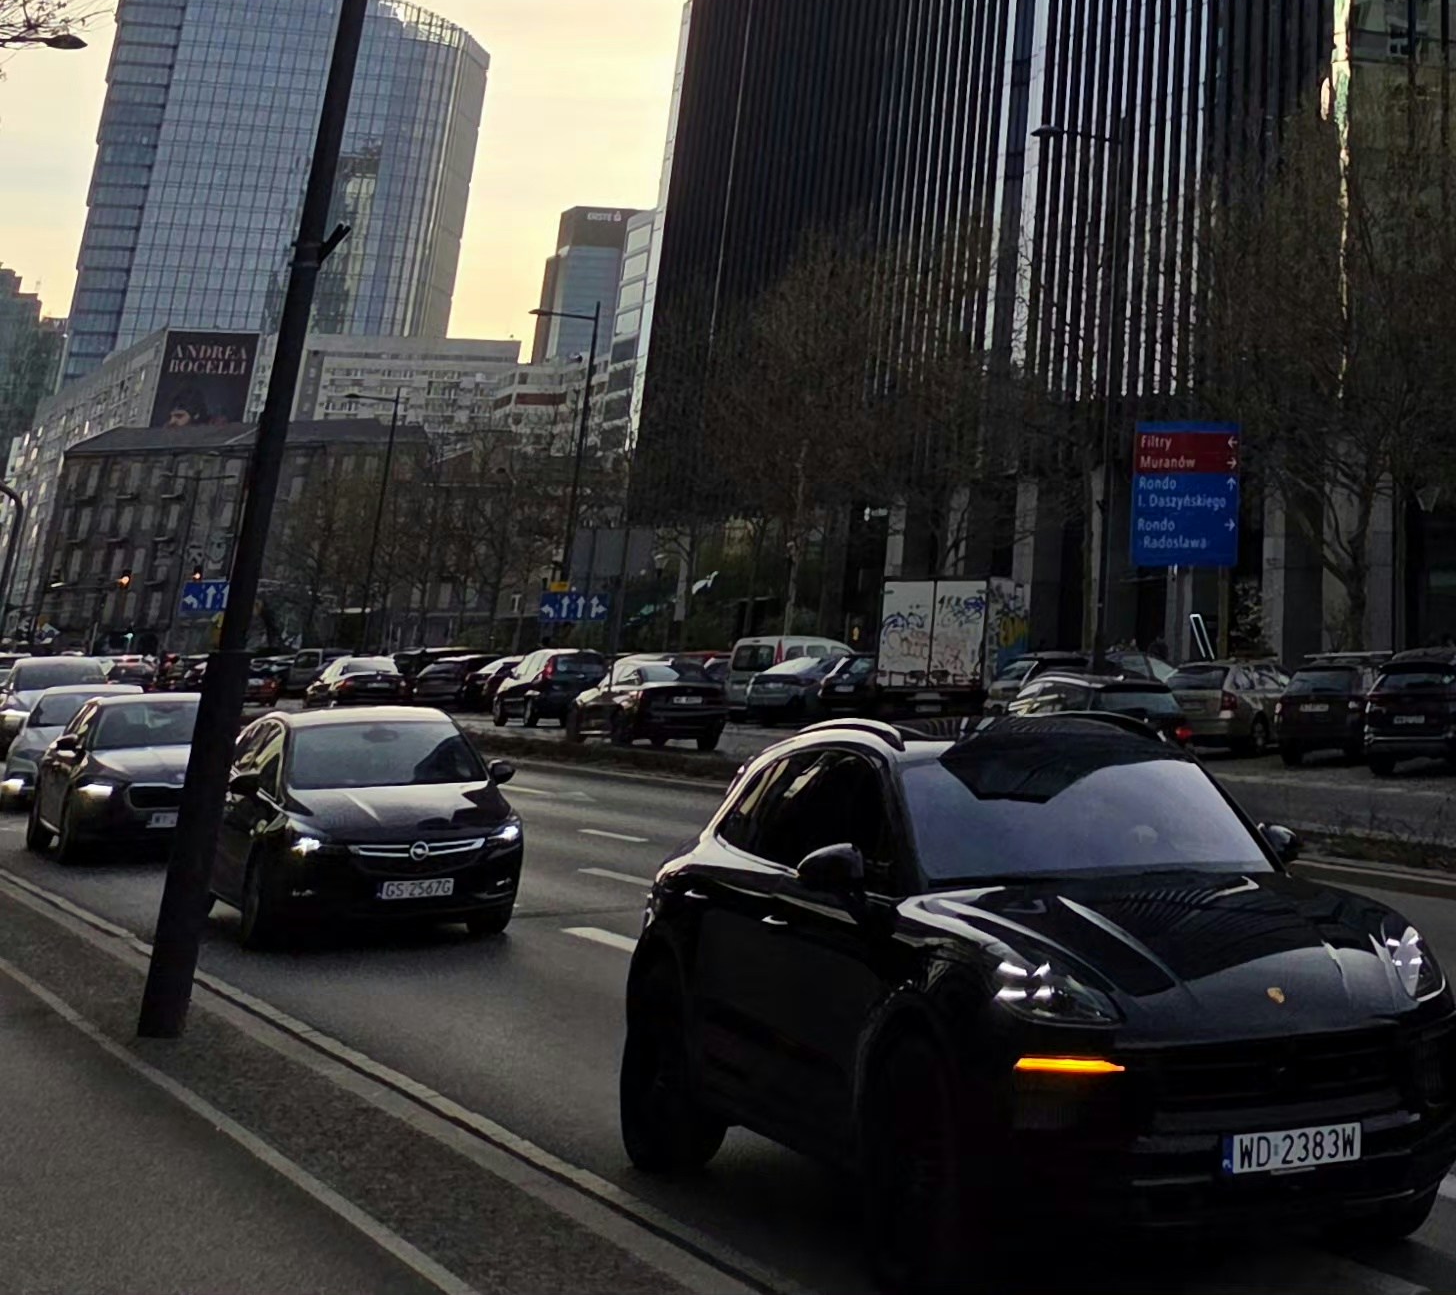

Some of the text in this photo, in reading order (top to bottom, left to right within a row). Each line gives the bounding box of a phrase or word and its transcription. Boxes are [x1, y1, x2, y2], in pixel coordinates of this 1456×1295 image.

[173, 344, 248, 360] ANDREA
[167, 358, 247, 375] BOCELLI
[1140, 434, 1172, 452] Filtry
[1140, 455, 1196, 469] Muranów
[1138, 476, 1177, 490] Rondo
[1149, 493, 1227, 511] Daszyńskiego
[1137, 517, 1175, 531] Rondo
[385, 882, 404, 898] GS
[1238, 1125, 1356, 1169] WD 2383W
